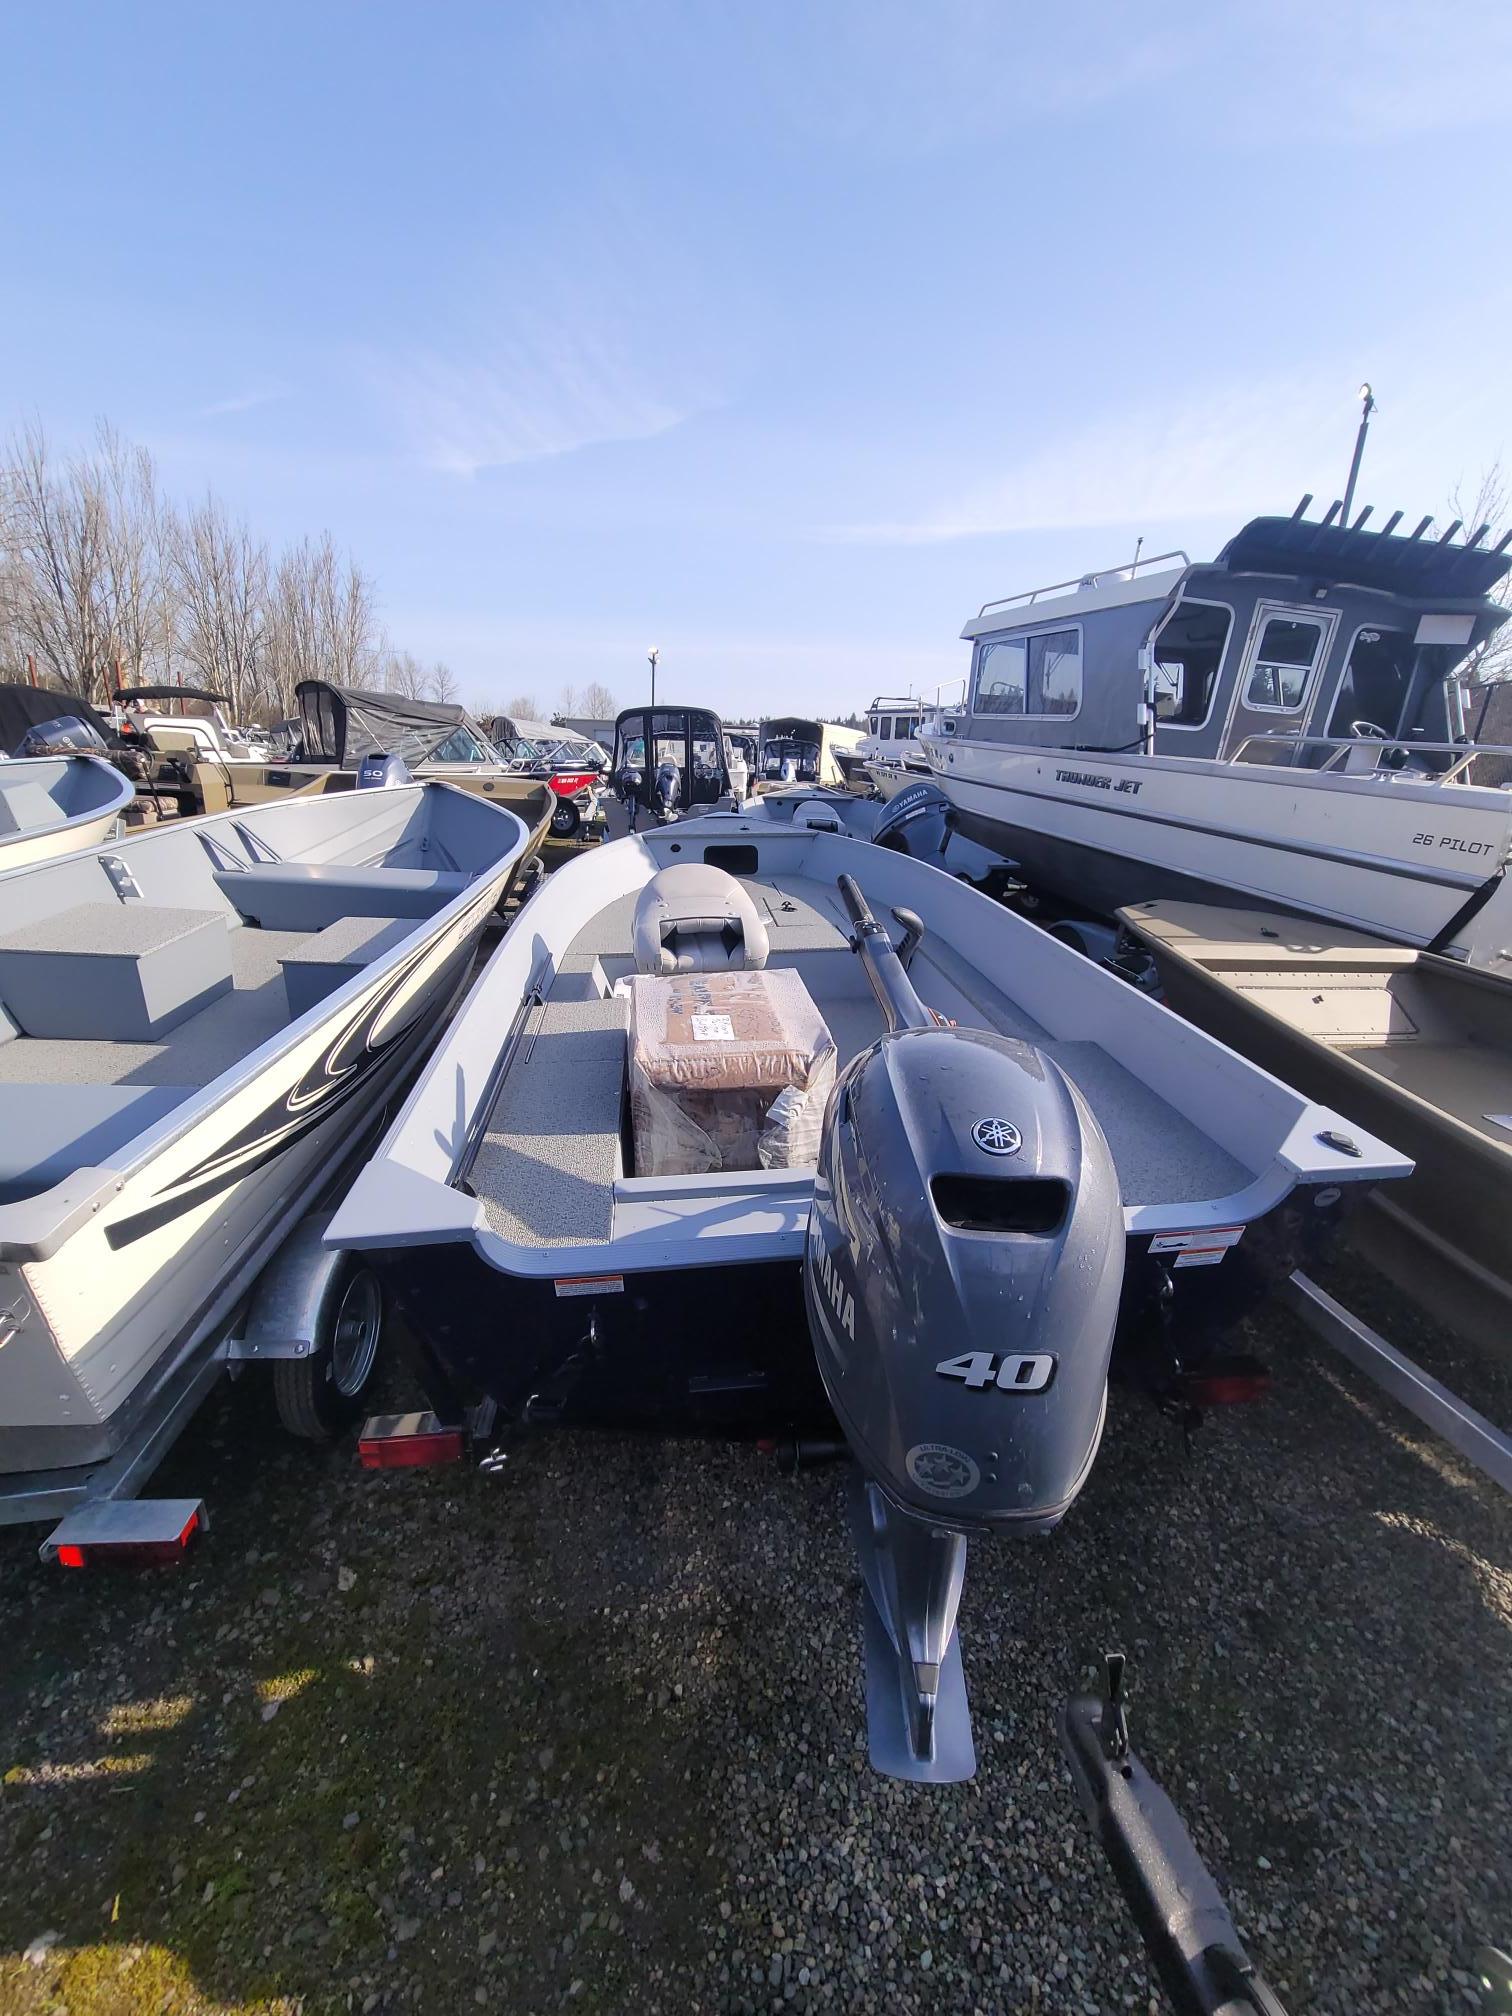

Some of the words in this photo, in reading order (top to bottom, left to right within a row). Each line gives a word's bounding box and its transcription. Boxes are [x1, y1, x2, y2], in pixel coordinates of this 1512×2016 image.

[363, 769, 383, 777] 50
[1055, 769, 1112, 790] THUNDER
[1113, 779, 1143, 795] JET
[899, 789, 928, 808] YAMAHA
[1412, 833, 1434, 846] 26
[1440, 837, 1495, 856] PILOT
[935, 1351, 1054, 1390] 40
